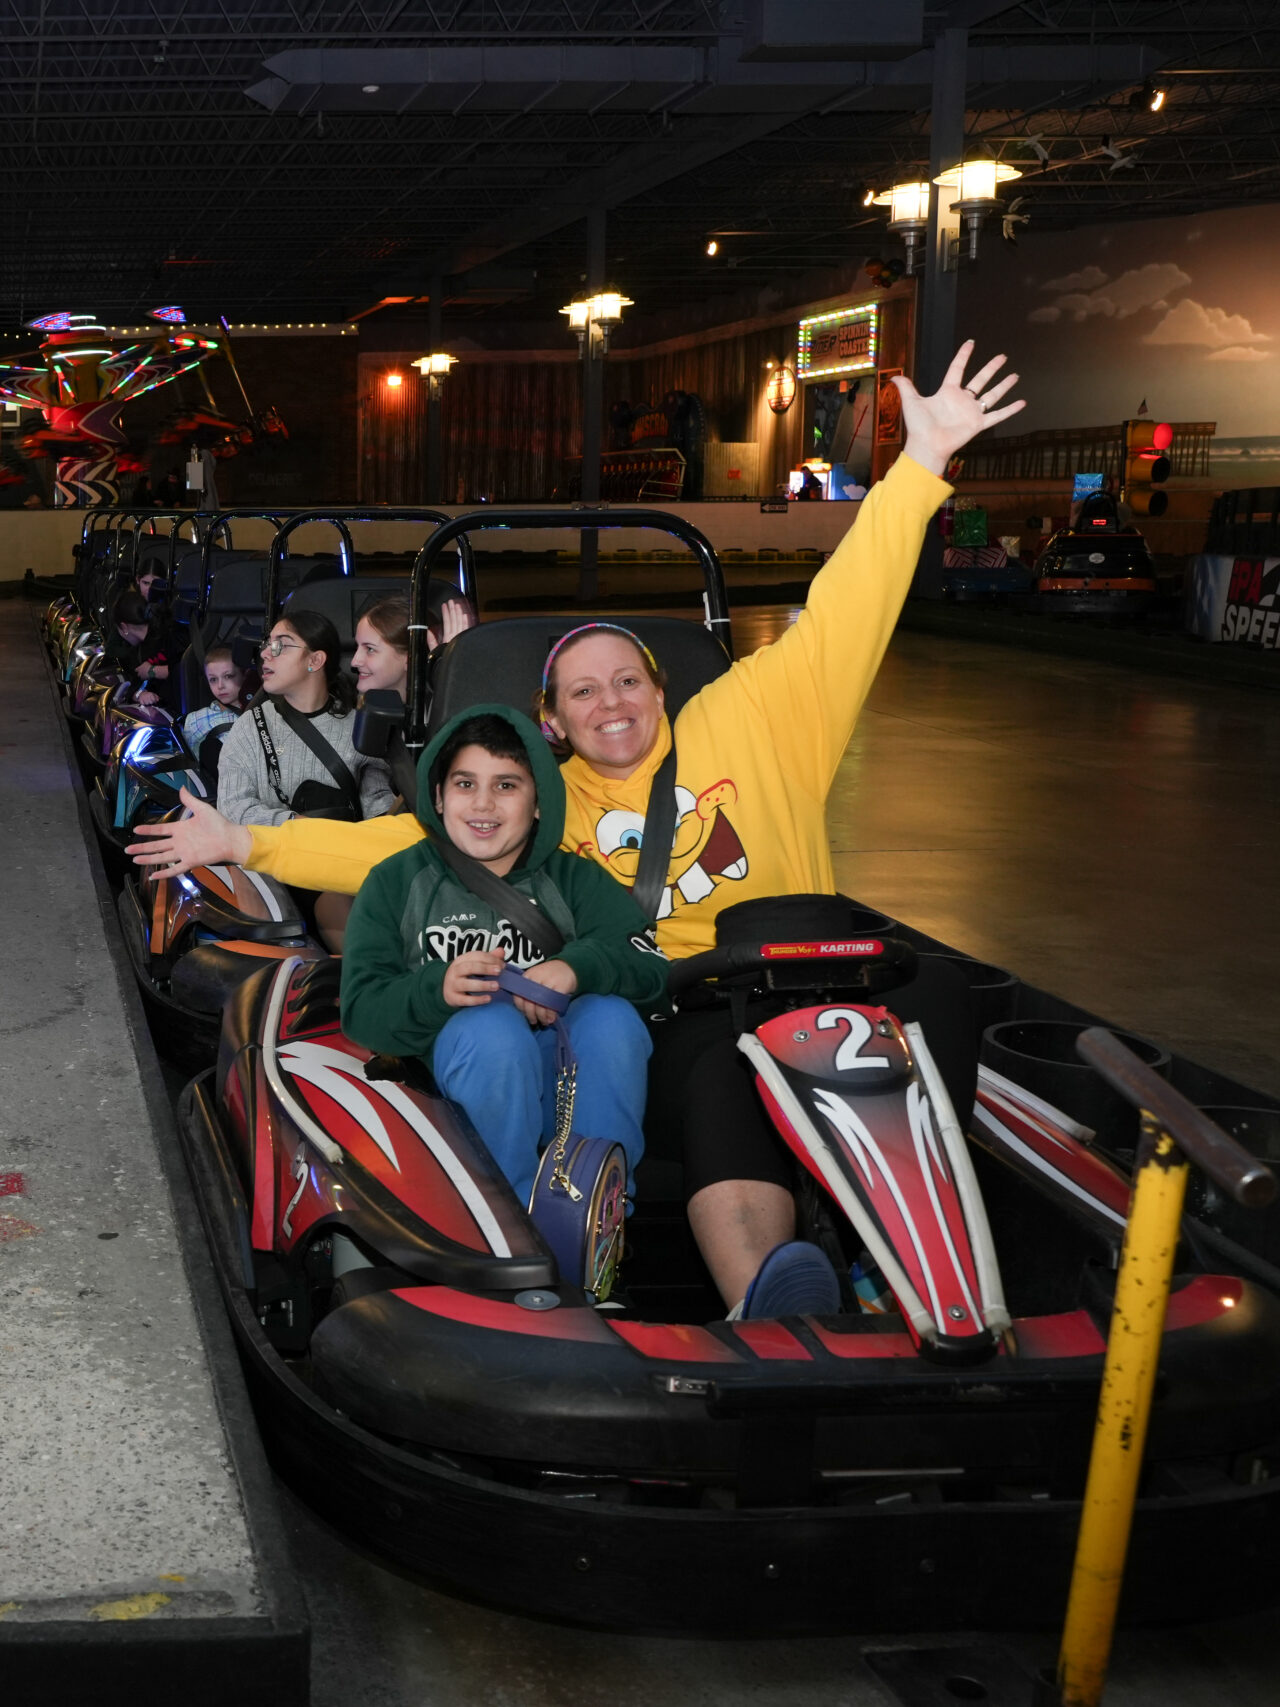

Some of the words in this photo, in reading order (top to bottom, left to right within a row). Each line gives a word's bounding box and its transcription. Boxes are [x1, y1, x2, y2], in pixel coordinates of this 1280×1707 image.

[839, 321, 870, 341] SPINNIN
[839, 337, 870, 358] COASTE
[1221, 604, 1280, 649] SPEE
[260, 730, 273, 754] adidas
[442, 913, 477, 924] CAMP
[820, 943, 874, 953] KARTING
[816, 1008, 890, 1072] 2
[282, 1162, 309, 1239] 2
